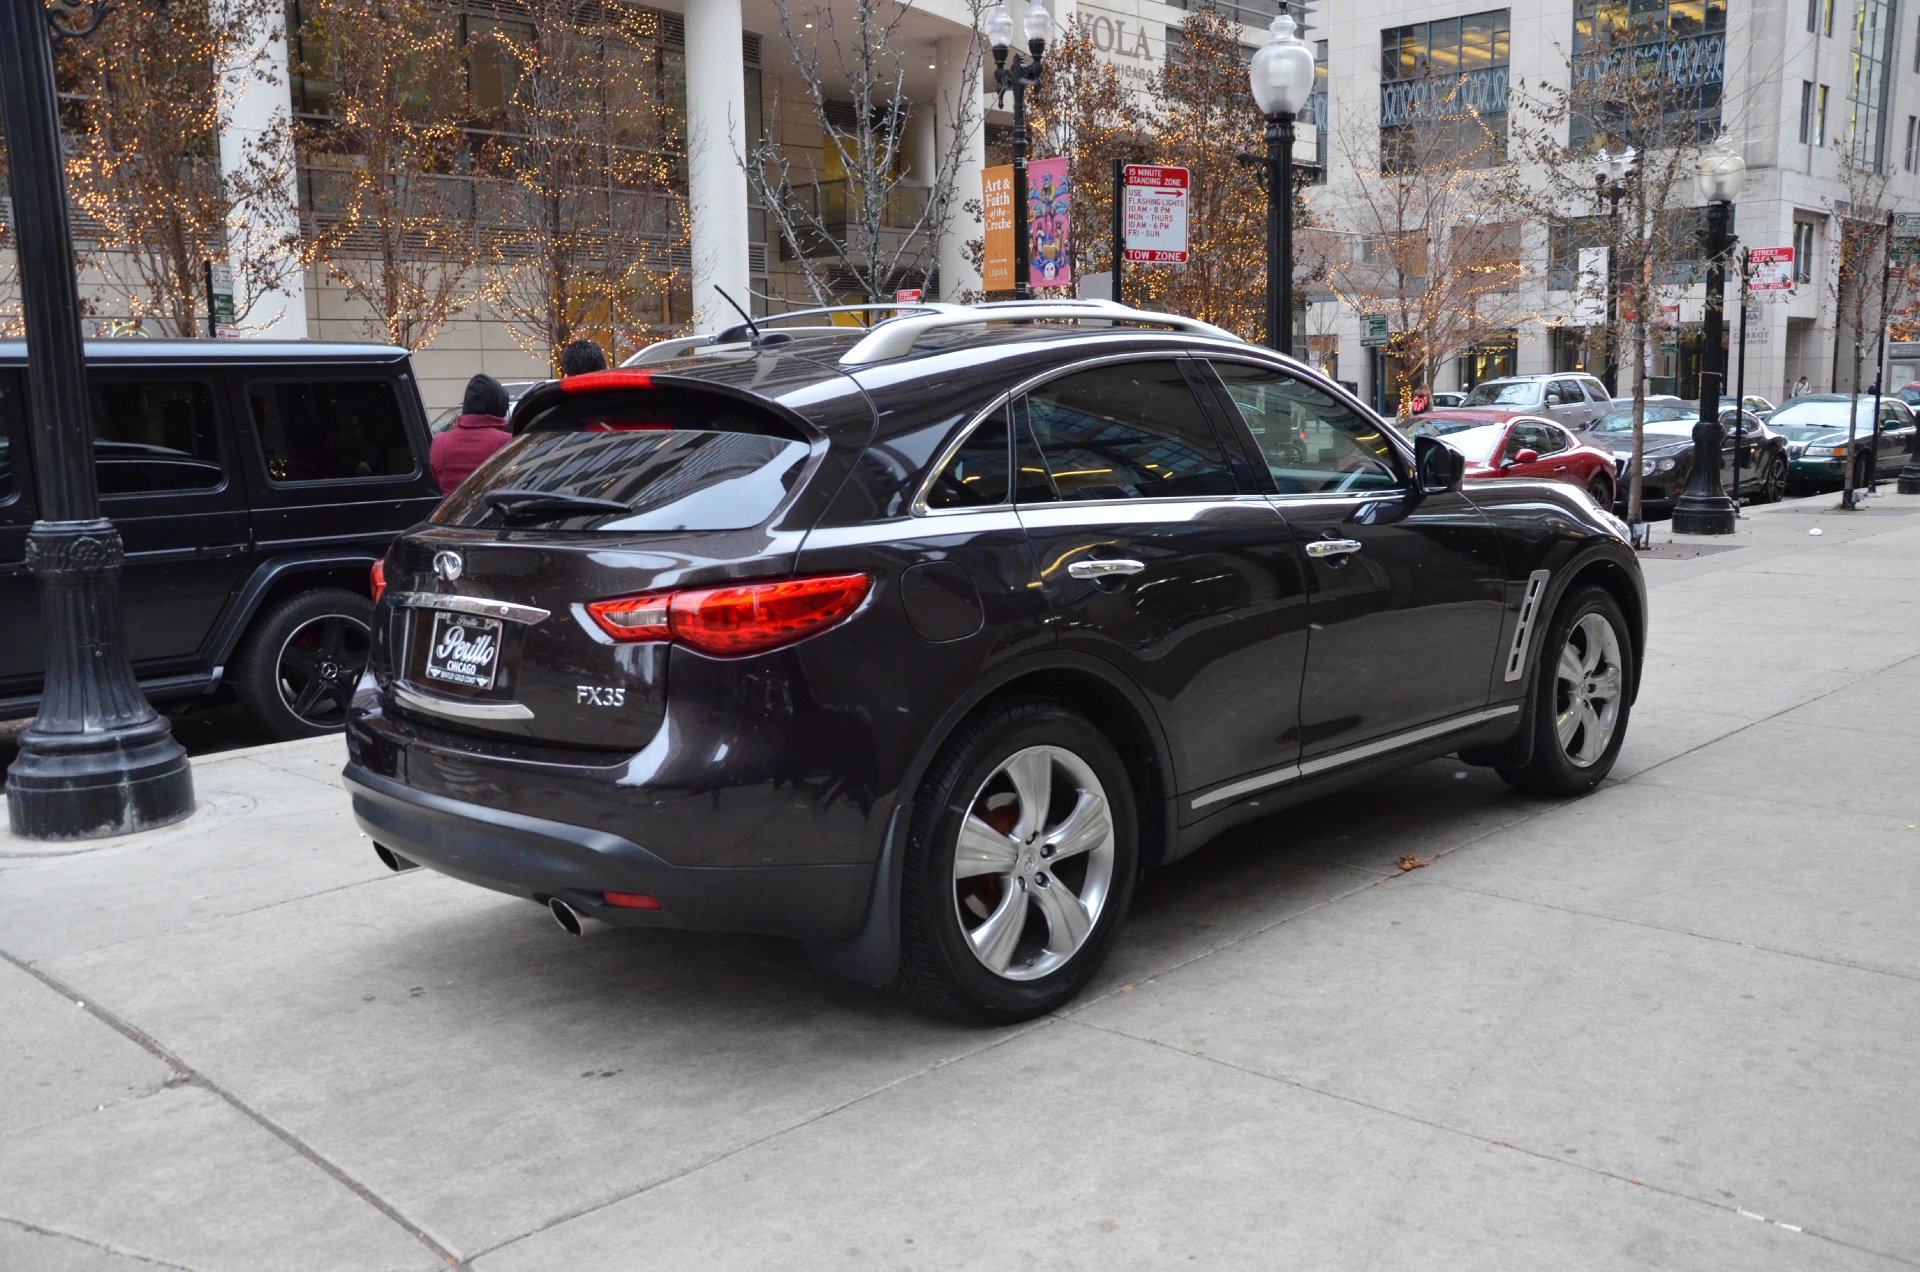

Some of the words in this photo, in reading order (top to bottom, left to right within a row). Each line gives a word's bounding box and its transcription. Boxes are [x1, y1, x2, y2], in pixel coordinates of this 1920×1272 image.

[1128, 168, 1136, 176] 15
[1137, 169, 1162, 177] MINUTE
[985, 179, 1001, 192] Art
[1003, 178, 1011, 190] &
[1129, 176, 1161, 185] STANDING
[1164, 178, 1182, 186] ZONE
[1128, 189, 1142, 197] USE
[985, 191, 1010, 207] Faith
[1128, 198, 1161, 206] FLASHING
[1162, 199, 1185, 207] LIGHTS
[997, 207, 1006, 217] the
[1160, 206, 1171, 214] PM
[1128, 213, 1144, 221] MON
[1151, 214, 1174, 222] THURS
[985, 217, 1012, 232] Creche
[1128, 250, 1150, 260] TOW
[1154, 251, 1182, 262] ZONE
[1733, 331, 1769, 340] CRBOY
[436, 626, 494, 666] Perillo
[447, 661, 476, 675] CHICAGO
[577, 685, 626, 707] FX35
